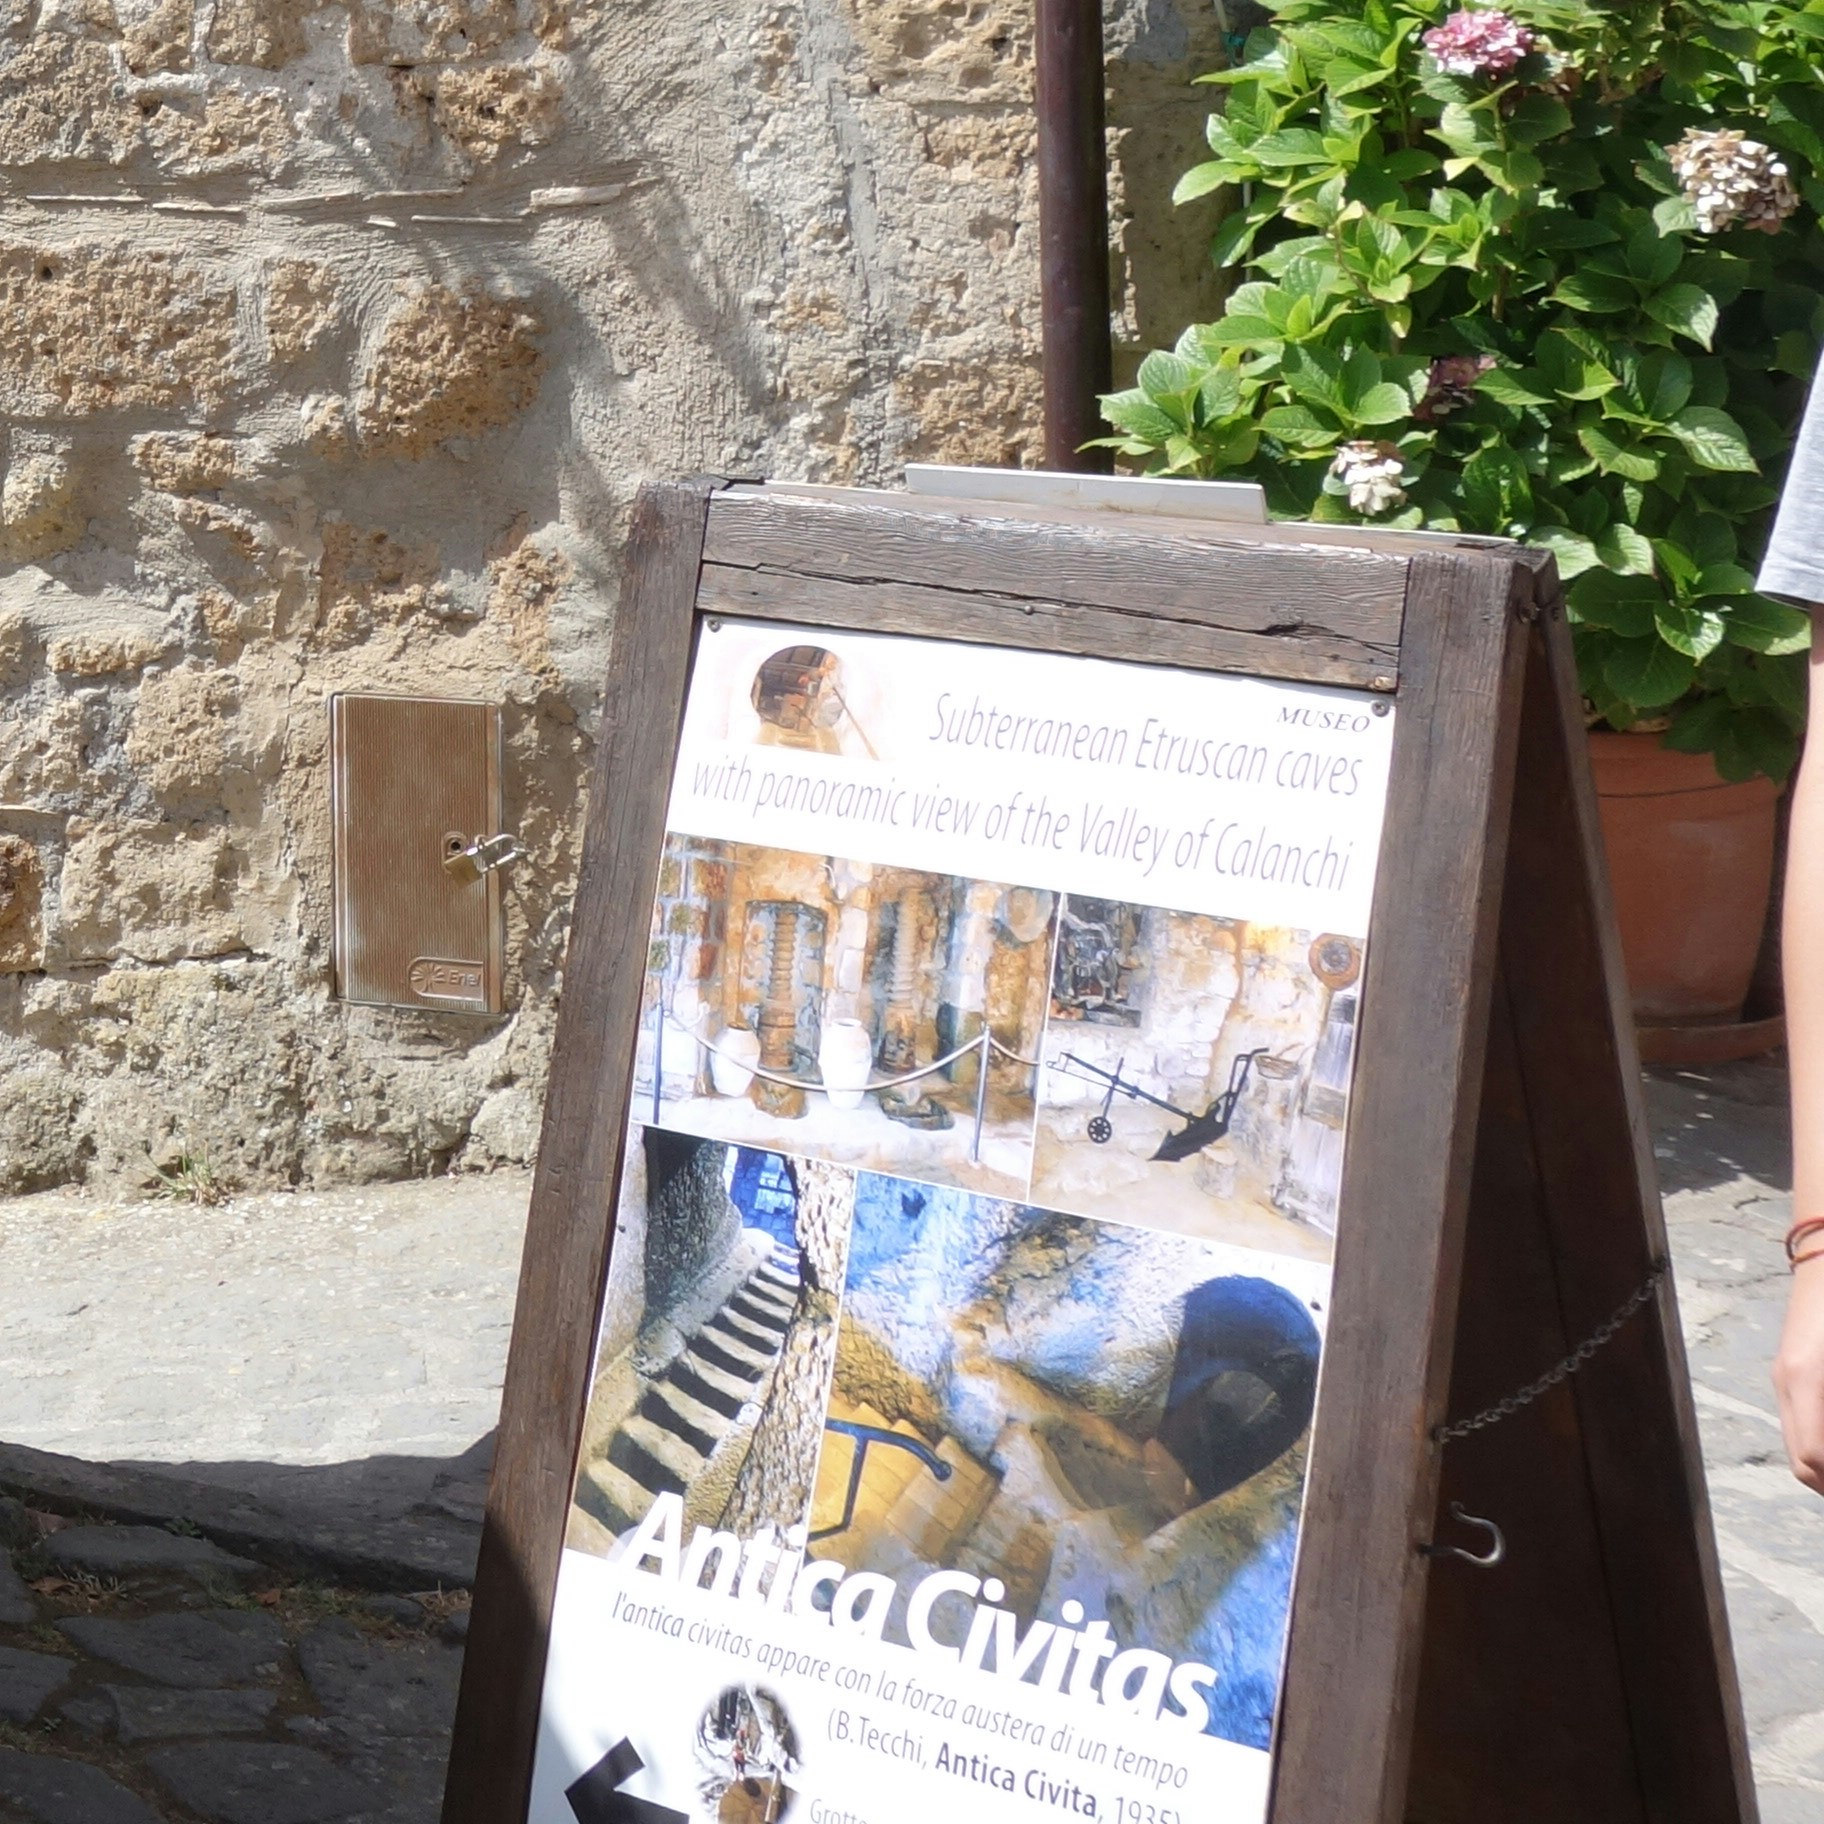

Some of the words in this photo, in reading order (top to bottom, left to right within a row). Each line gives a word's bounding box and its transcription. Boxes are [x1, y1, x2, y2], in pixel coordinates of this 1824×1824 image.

[928, 692, 1129, 766] Subterranean
[1135, 717, 1269, 784] Etruscan
[1276, 749, 1364, 796] caves
[1276, 706, 1371, 733] MUSEO
[692, 754, 753, 803] with
[753, 769, 907, 826] panoramic
[910, 783, 981, 835] view
[985, 791, 1024, 841] of
[1020, 796, 1070, 850] the
[1080, 802, 1170, 877] Valley
[1174, 818, 1215, 869] of
[1215, 822, 1354, 891] Calanchi
[614, 1490, 897, 1641] Antica
[906, 1569, 1219, 1735] Civitas
[612, 1591, 686, 1638] l'antica
[688, 1618, 753, 1659] civitas
[756, 1642, 831, 1682] appare
[834, 1665, 871, 1694] con
[875, 1670, 898, 1702] la
[901, 1678, 958, 1719] forza
[961, 1704, 1046, 1746] austera
[1050, 1724, 1075, 1754] di
[1077, 1737, 1108, 1765] un
[1114, 1745, 1189, 1791] tempo
[810, 1798, 868, 1824] Grott
[827, 1708, 927, 1770] (B.Tecchi,
[935, 1742, 1016, 1793] Antica
[1023, 1769, 1104, 1824] Civita,
